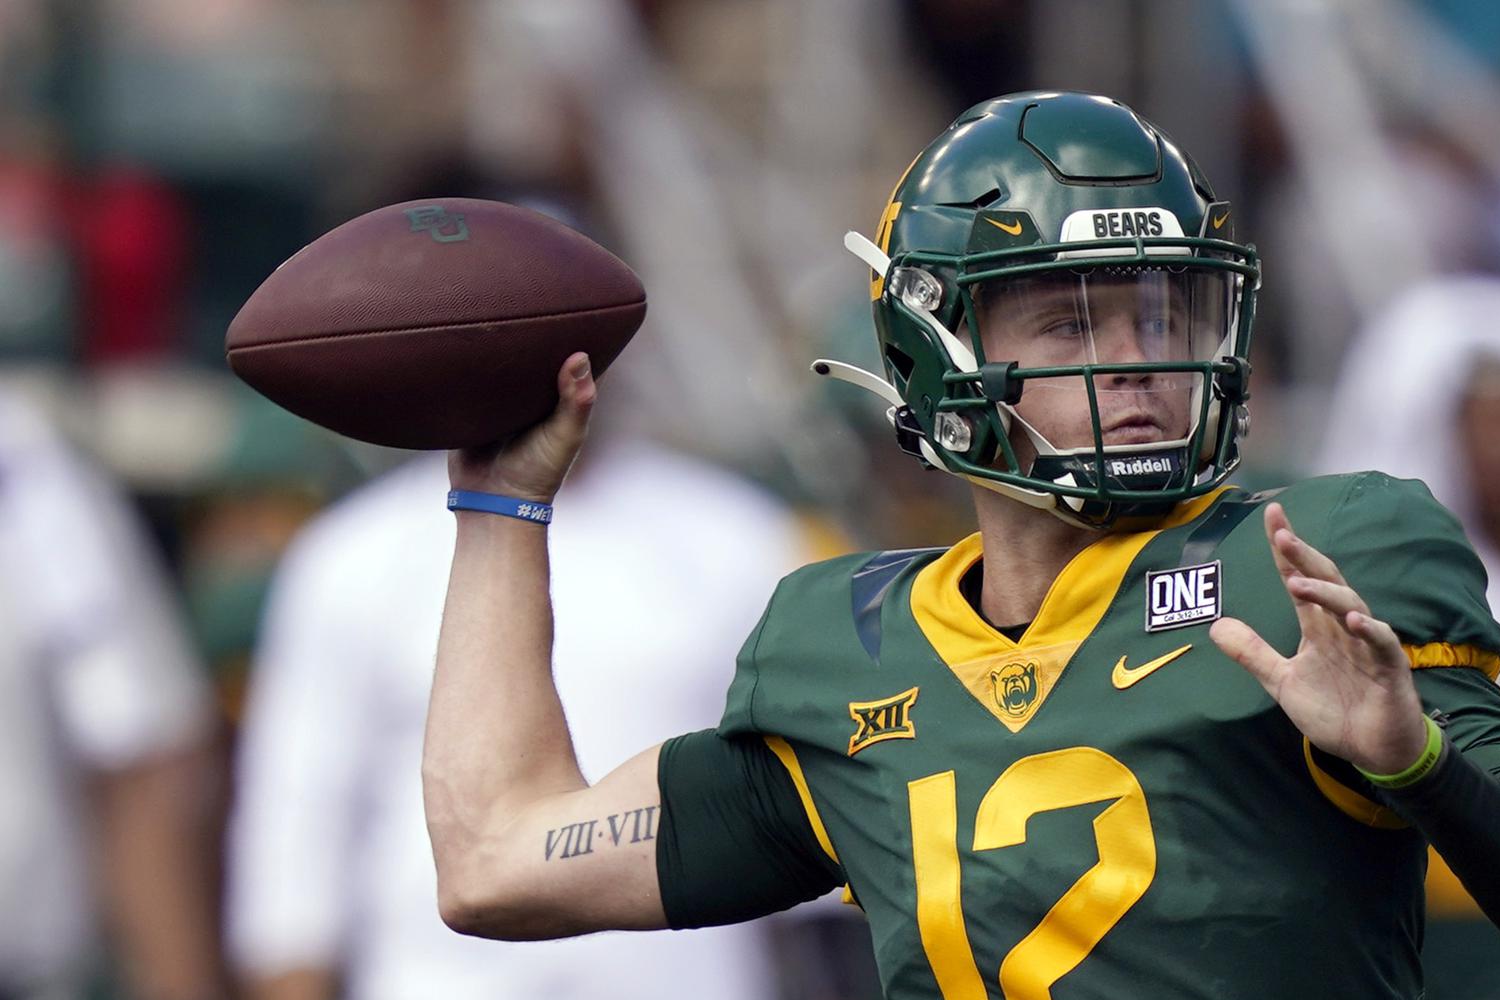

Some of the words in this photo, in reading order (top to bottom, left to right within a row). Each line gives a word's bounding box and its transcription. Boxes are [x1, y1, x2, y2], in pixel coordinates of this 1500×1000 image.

[402, 204, 469, 243] BU
[1092, 211, 1163, 238] BEARS
[1111, 457, 1172, 476] Riddell
[1152, 566, 1217, 615] ONE
